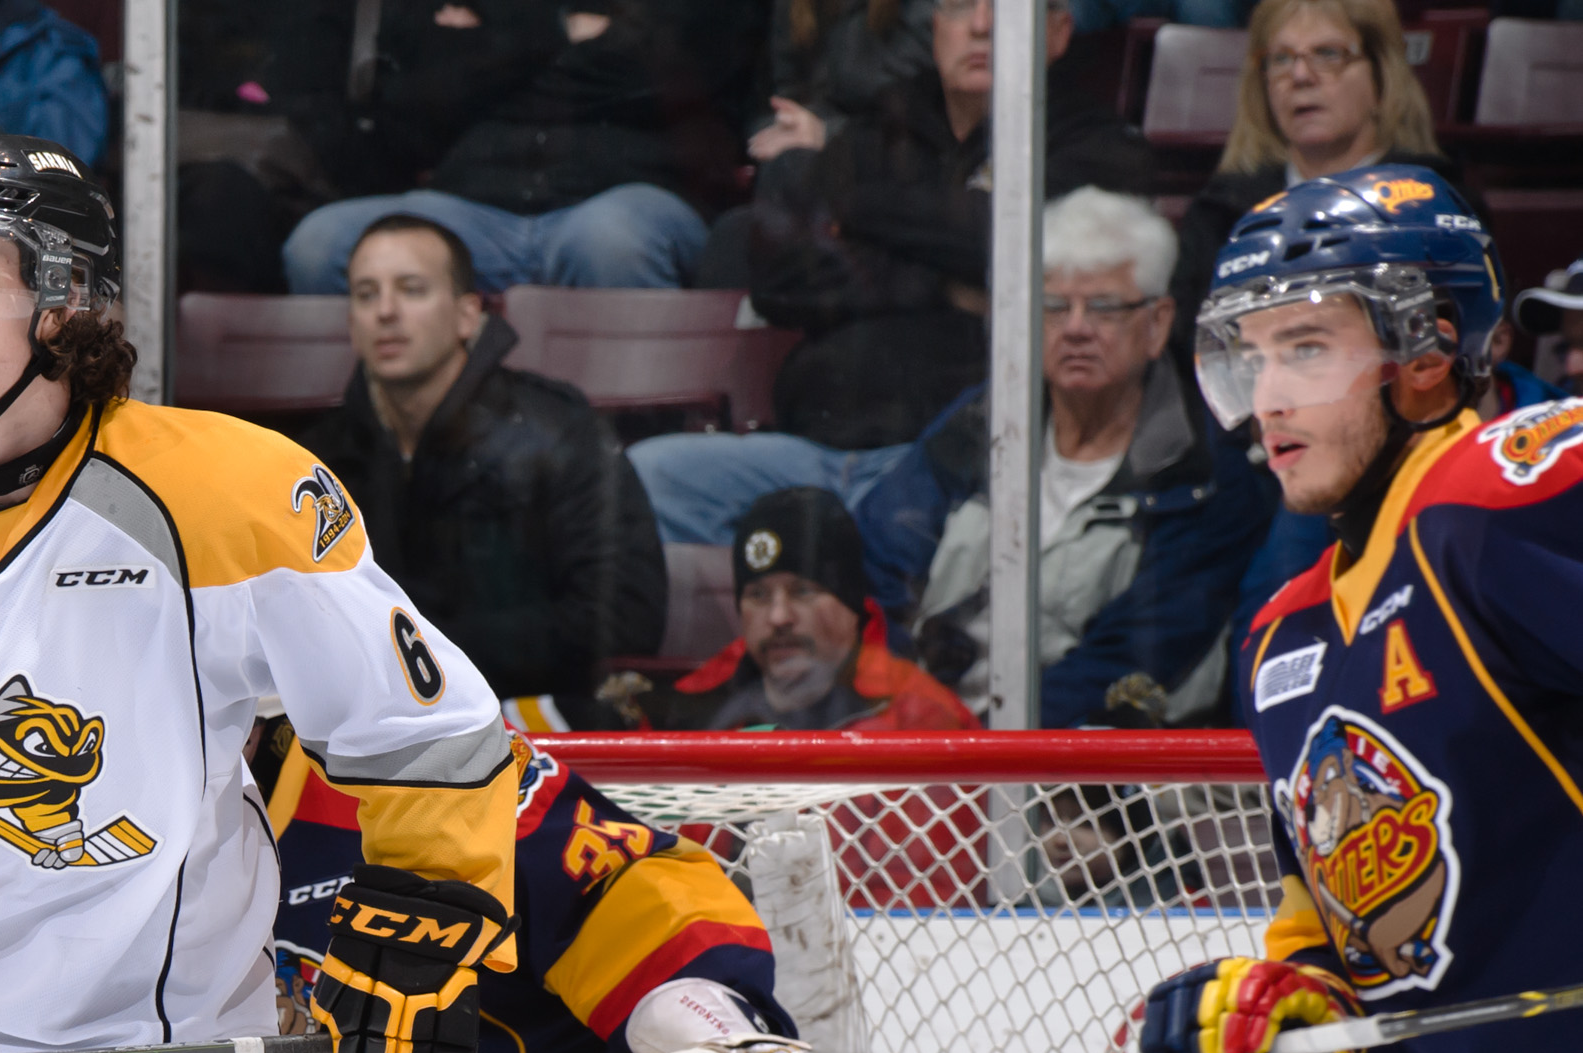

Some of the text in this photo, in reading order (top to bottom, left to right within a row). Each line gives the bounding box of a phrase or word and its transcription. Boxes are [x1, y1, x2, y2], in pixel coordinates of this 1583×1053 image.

[28, 151, 83, 180] SARNIA
[42, 254, 73, 265] BAUER
[55, 568, 150, 588] CCM
[1359, 584, 1415, 635] CCM
[390, 606, 446, 704] 6
[1381, 618, 1439, 712] A
[562, 796, 654, 896] 35
